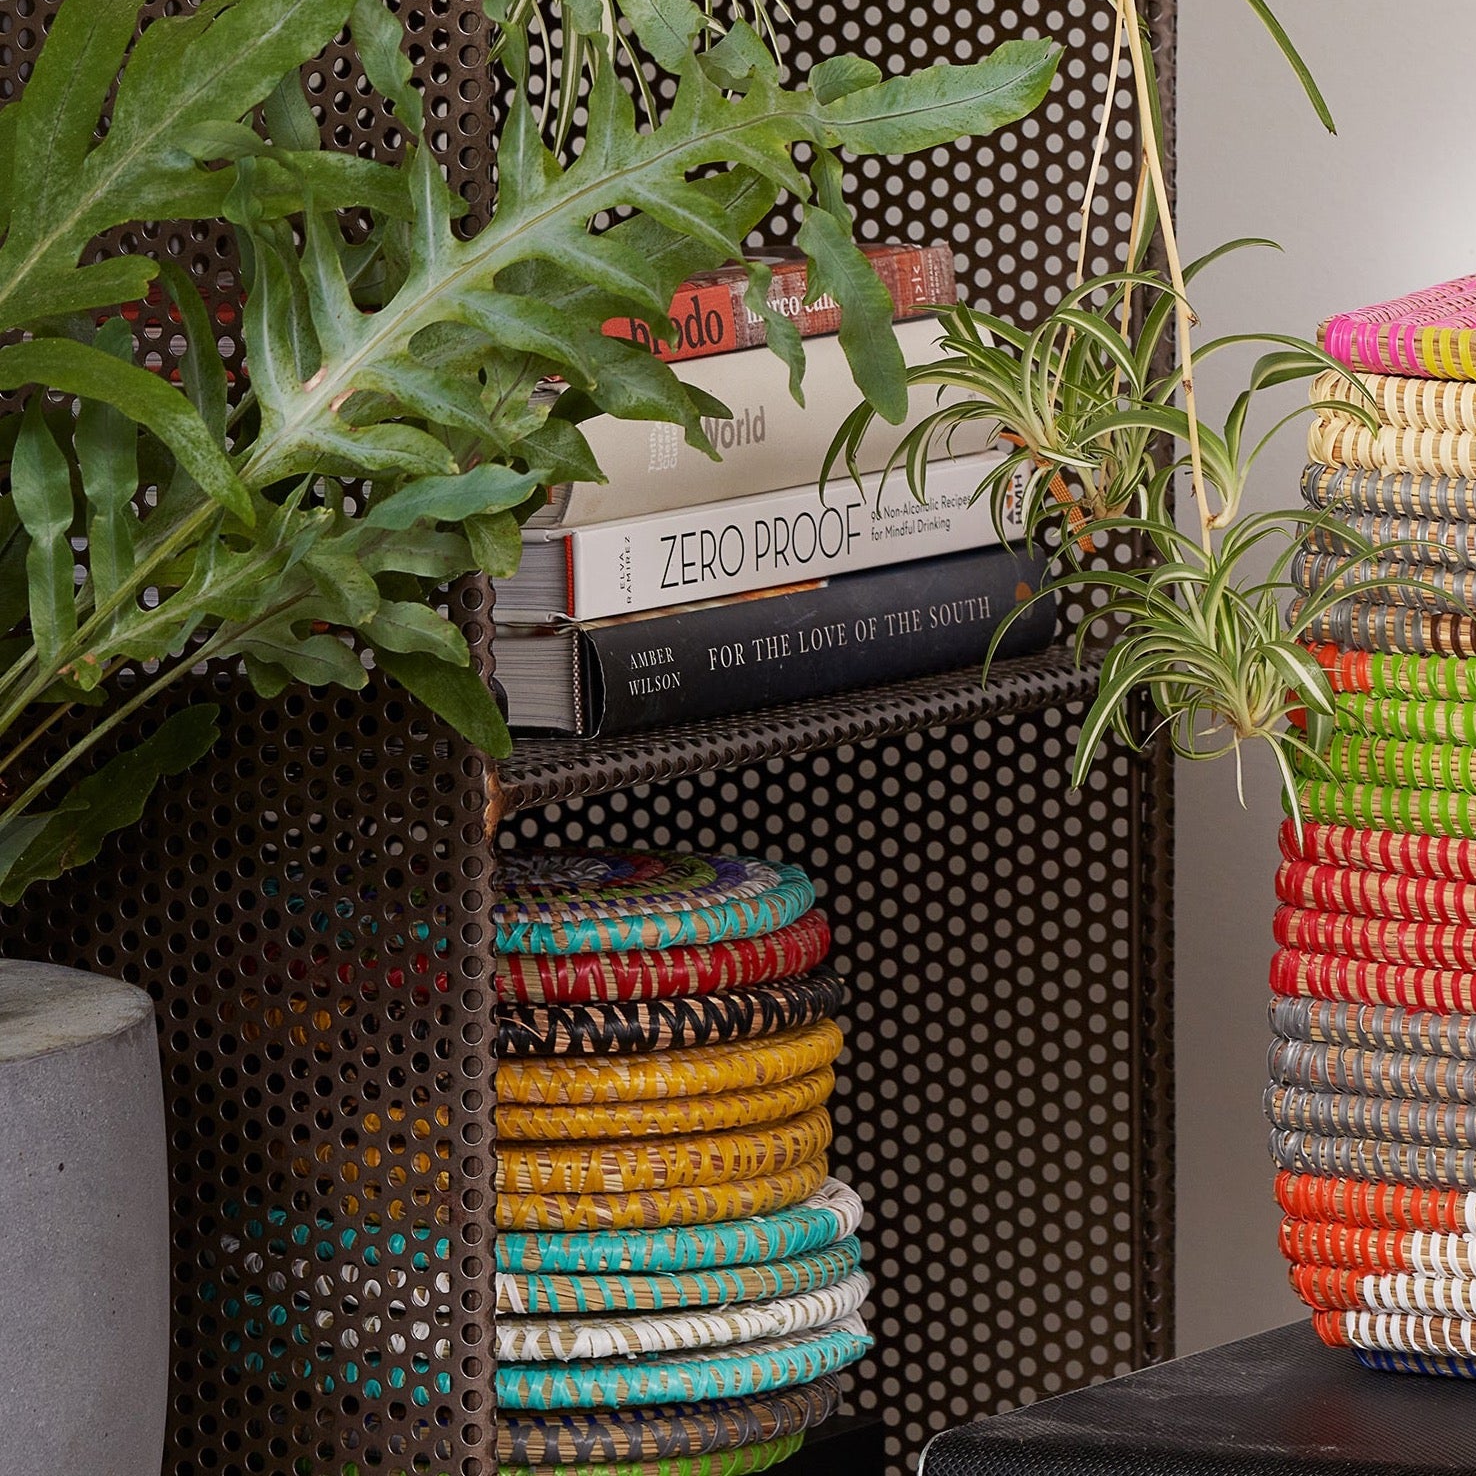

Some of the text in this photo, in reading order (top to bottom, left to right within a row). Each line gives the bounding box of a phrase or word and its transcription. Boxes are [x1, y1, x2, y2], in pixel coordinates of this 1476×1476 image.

[745, 295, 801, 324] mrco
[669, 425, 679, 469] Cutle
[1014, 474, 1023, 525] HMH
[660, 502, 862, 589] ZERO PROOF
[870, 515, 951, 542] for Mindful Drinking
[624, 536, 633, 604] RAMIREZ
[707, 595, 992, 671] FOR THE LOVE OF THE SOUTH
[629, 646, 675, 670] AMBER
[627, 671, 682, 696] WILSON
